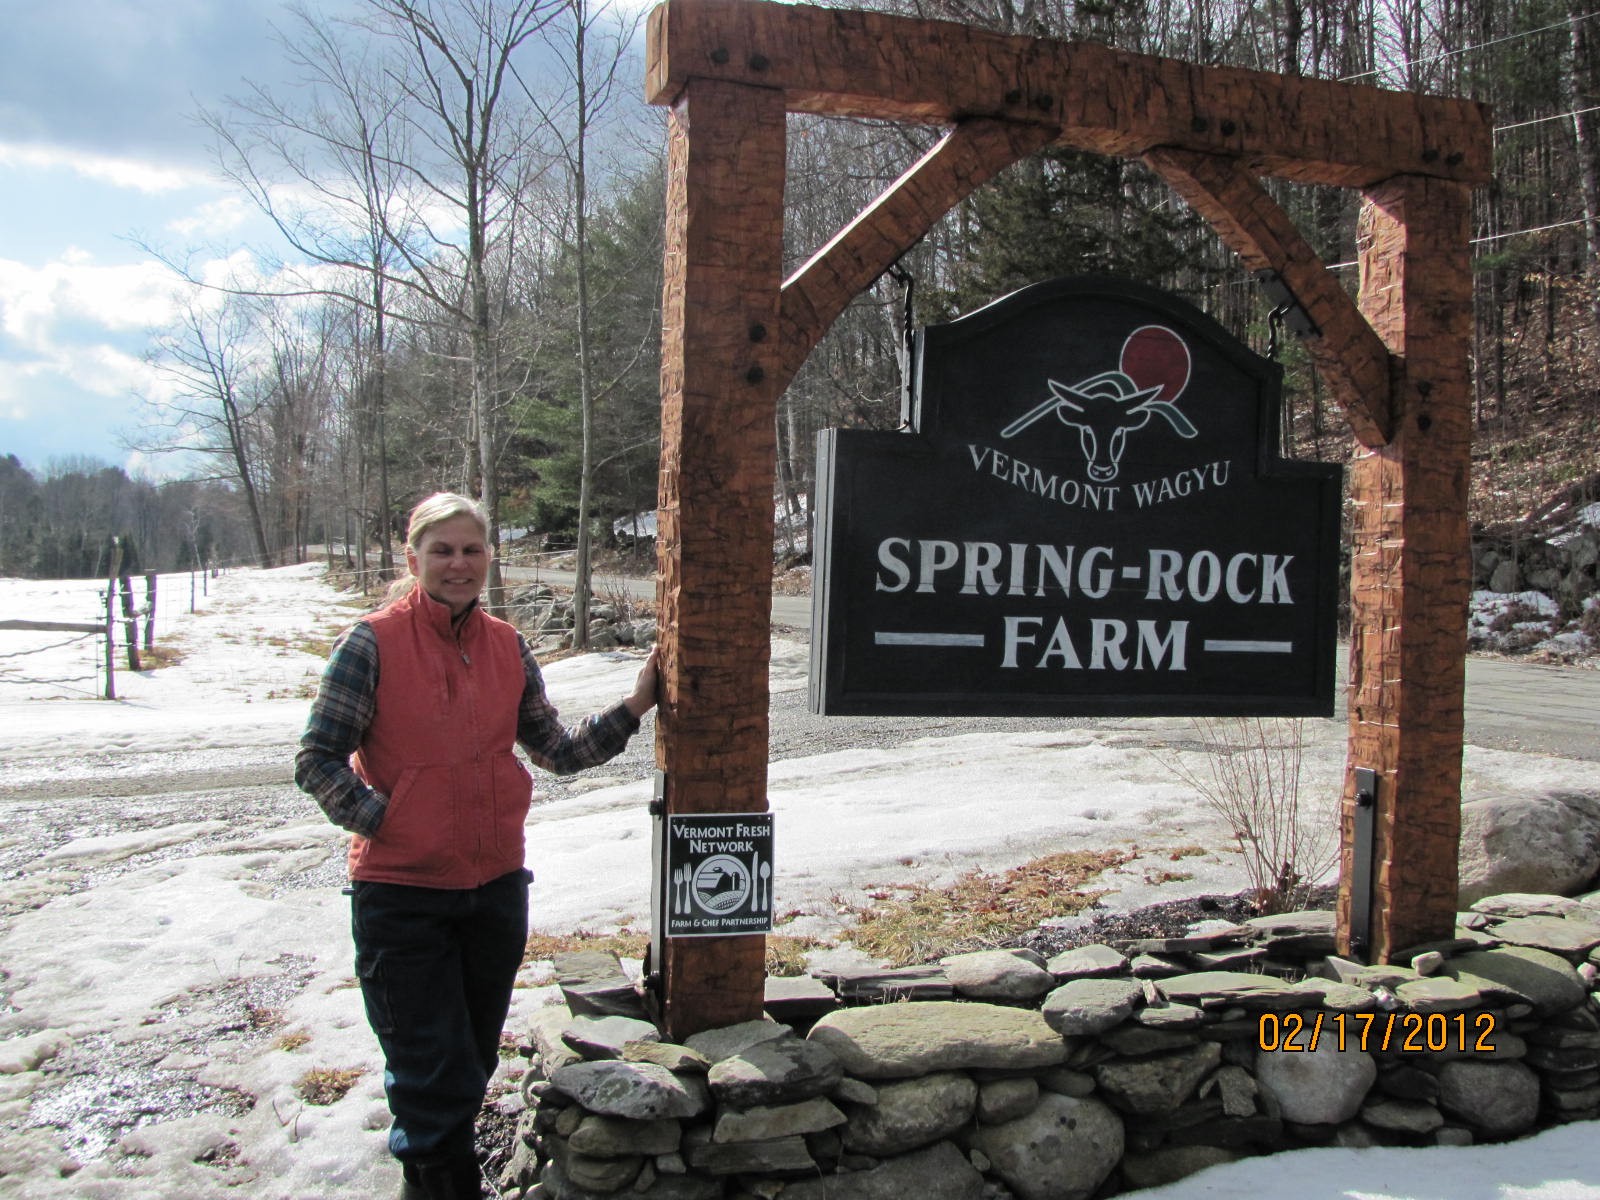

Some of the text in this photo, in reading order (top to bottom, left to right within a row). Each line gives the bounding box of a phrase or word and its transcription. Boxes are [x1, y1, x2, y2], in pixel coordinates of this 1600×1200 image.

[967, 444, 1231, 511] VERMONT WAGYU
[875, 537, 1295, 604] SPRING-ROCK
[1000, 615, 1190, 671] FARM
[693, 919, 701, 927] &
